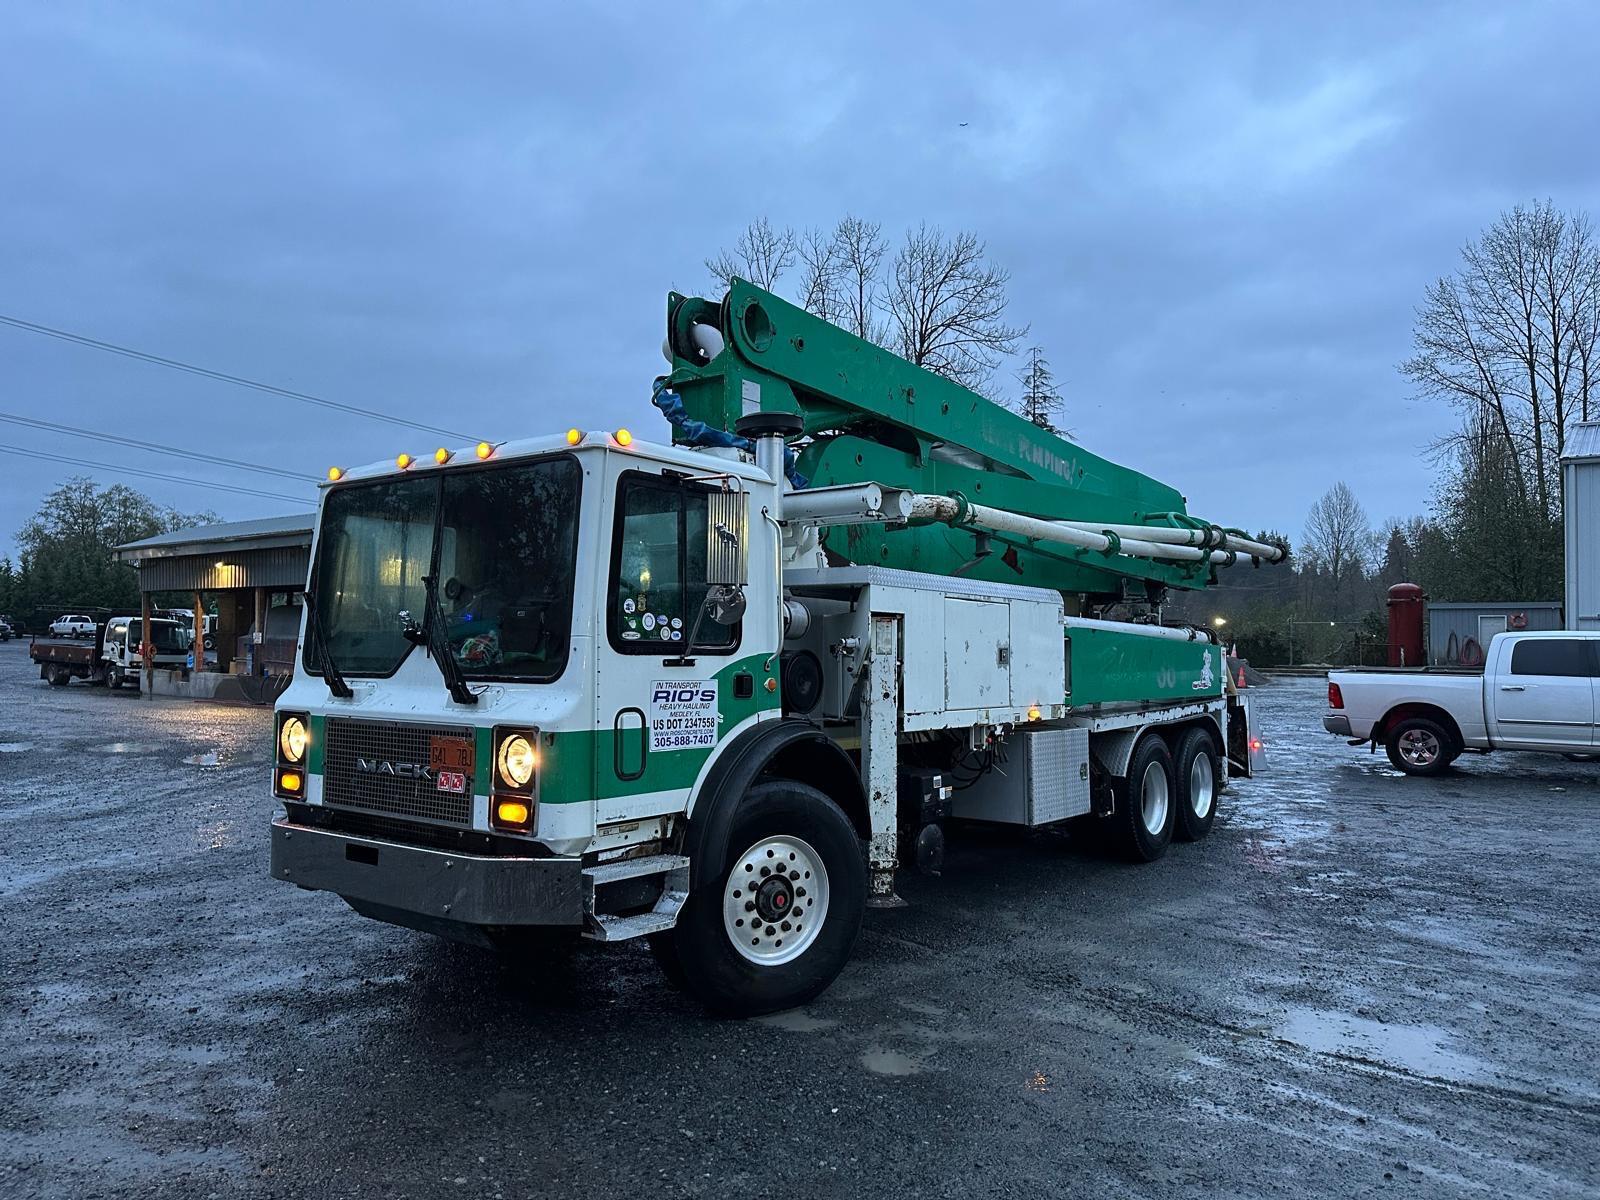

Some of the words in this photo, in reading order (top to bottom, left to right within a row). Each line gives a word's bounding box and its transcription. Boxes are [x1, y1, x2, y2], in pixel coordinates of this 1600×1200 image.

[653, 690, 716, 703] RIO'S
[659, 703, 682, 711] HEAVY
[653, 719, 664, 730] US
[667, 719, 682, 729] DOT
[684, 717, 715, 728] 2347558
[654, 735, 714, 747] 305-888-7407
[357, 758, 432, 780] MACK
